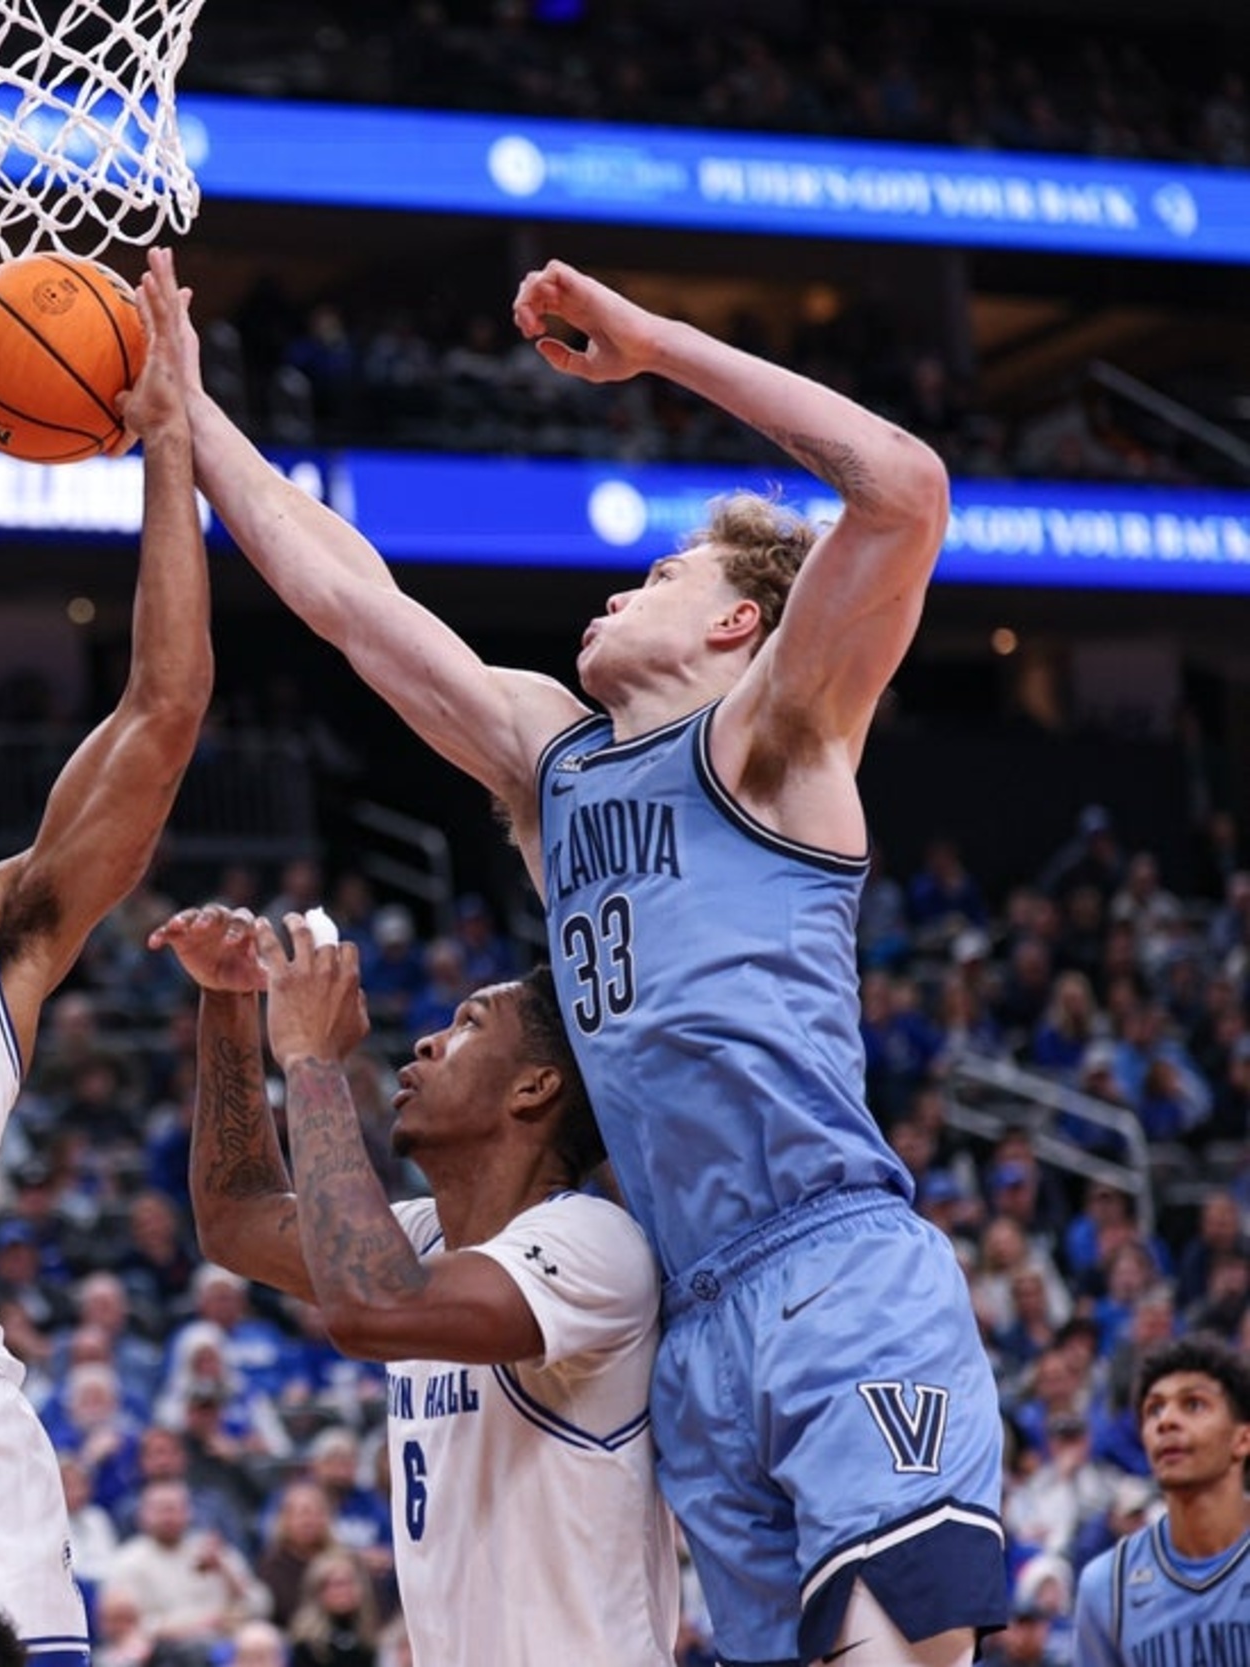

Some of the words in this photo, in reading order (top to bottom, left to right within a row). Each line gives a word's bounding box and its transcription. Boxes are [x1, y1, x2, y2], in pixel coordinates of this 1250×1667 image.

[1036, 178, 1139, 230] BACK
[561, 892, 636, 1037] 33
[424, 1369, 480, 1420] HALL
[856, 1381, 950, 1476] V
[402, 1440, 428, 1542] 6
